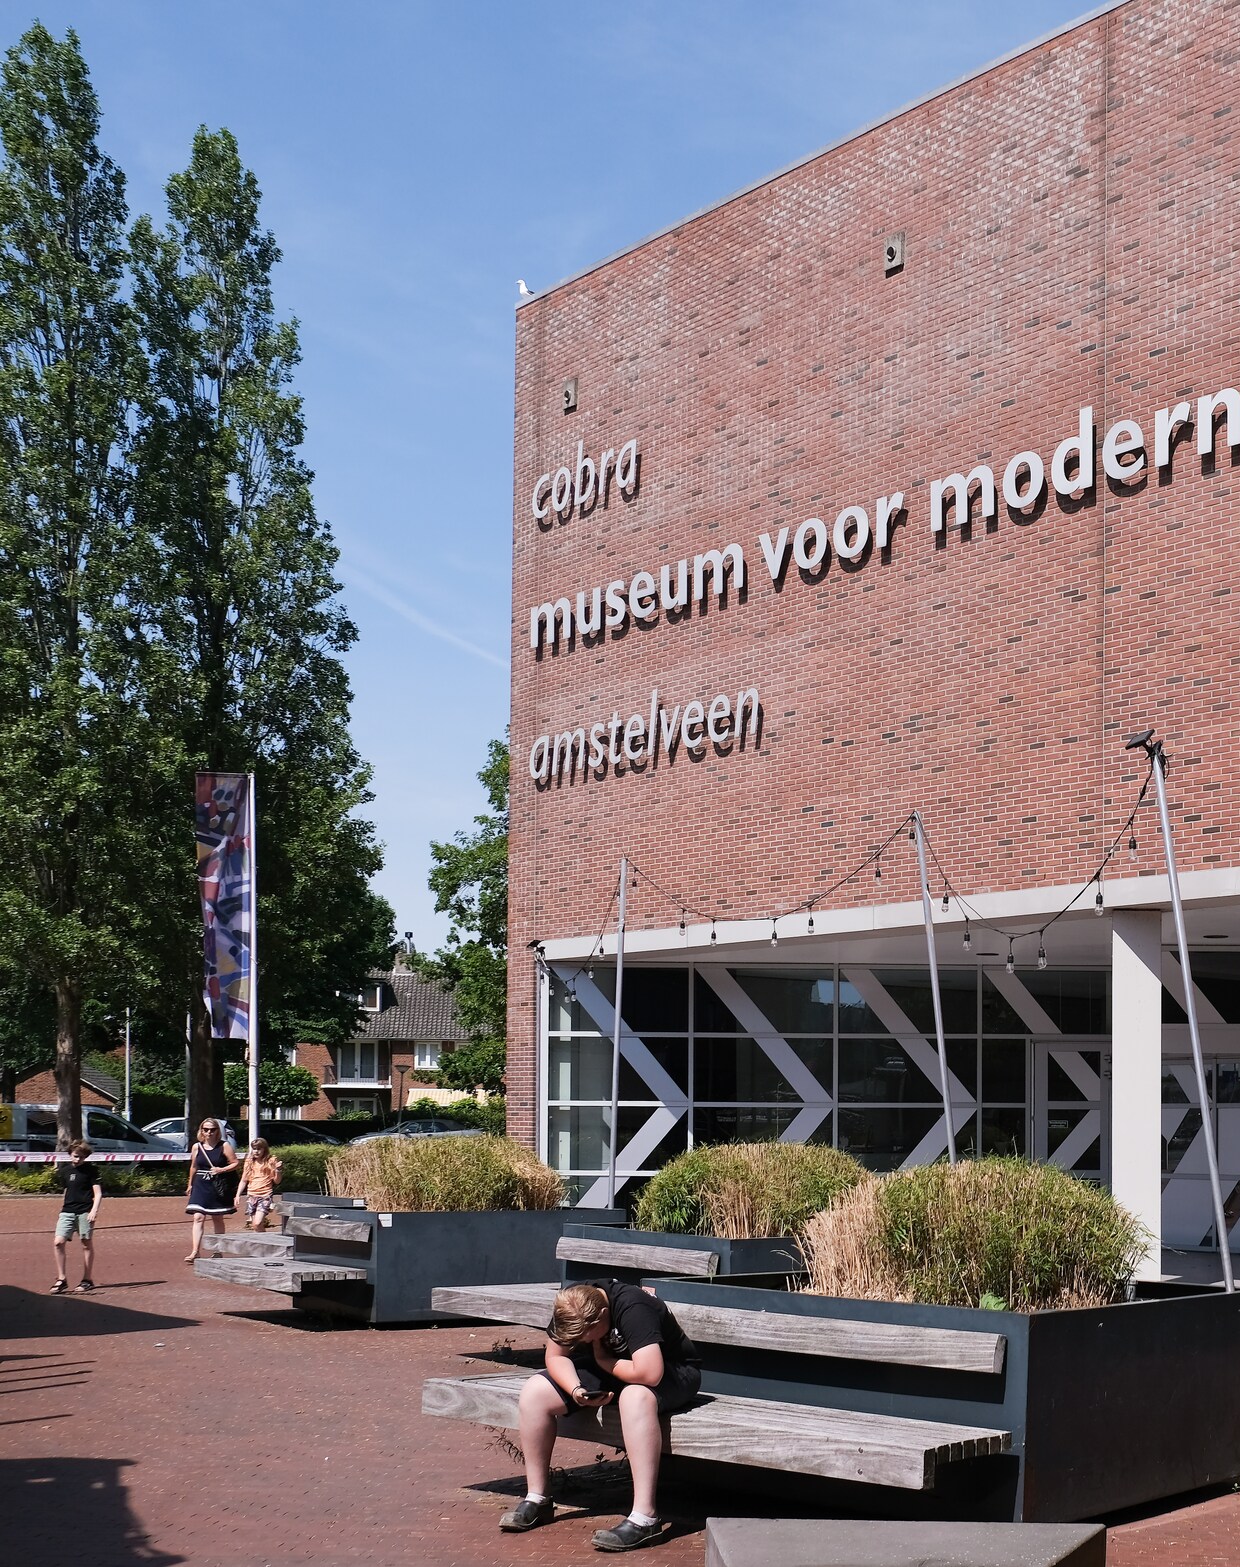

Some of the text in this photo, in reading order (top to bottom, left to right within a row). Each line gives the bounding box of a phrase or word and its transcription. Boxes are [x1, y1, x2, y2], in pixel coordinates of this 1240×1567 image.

[531, 438, 638, 520] cobra
[529, 540, 744, 649] museum
[758, 490, 905, 581] voor
[529, 687, 760, 781] amstelveen
